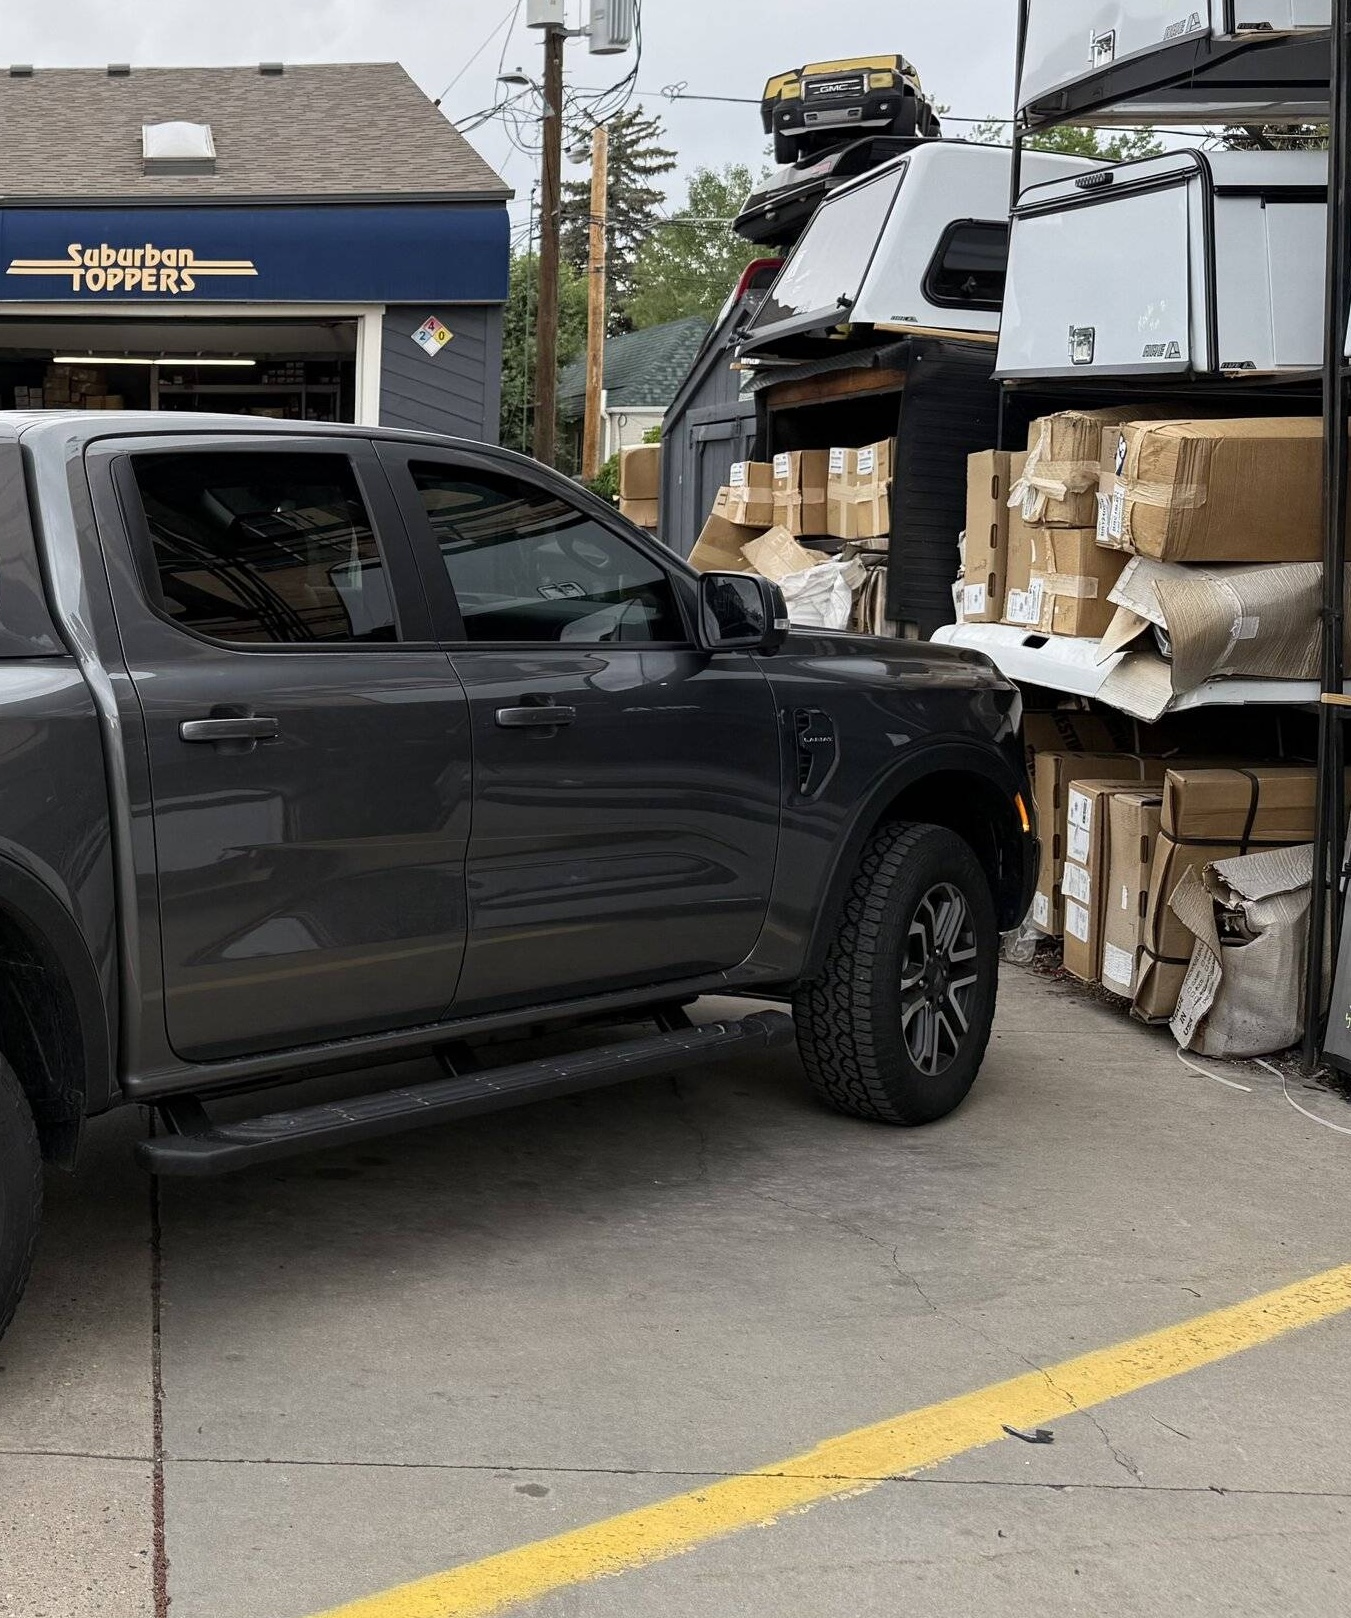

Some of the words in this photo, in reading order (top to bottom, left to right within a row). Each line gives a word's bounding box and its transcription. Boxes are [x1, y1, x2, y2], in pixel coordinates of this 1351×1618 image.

[819, 84, 849, 93] GMC
[67, 243, 195, 267] Suburban
[71, 268, 196, 294] TOPPERS
[428, 321, 436, 331] 4
[419, 331, 426, 341] 2
[438, 330, 445, 341] 0
